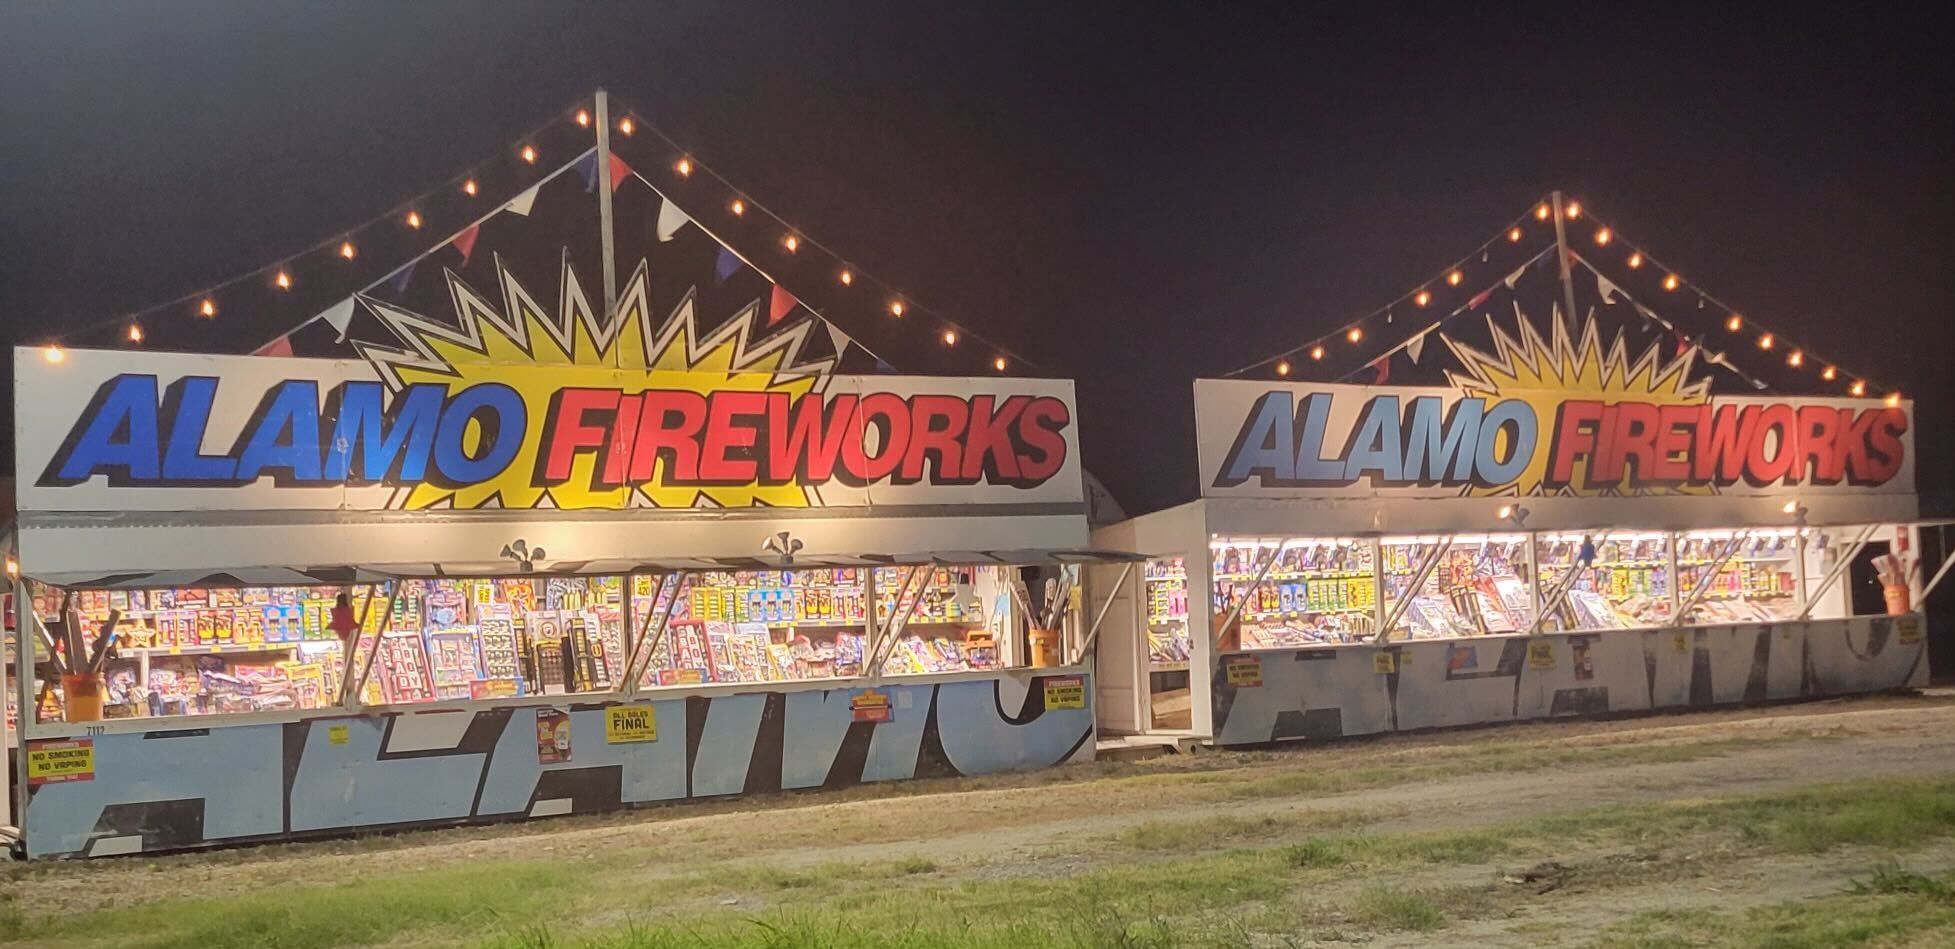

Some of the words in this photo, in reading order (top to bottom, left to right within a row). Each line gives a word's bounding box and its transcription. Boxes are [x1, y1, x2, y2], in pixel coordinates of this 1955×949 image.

[34, 373, 528, 489] ALAMO
[530, 386, 1069, 489] FIREWORKS
[1212, 391, 1538, 487] ALAMO
[1544, 399, 1908, 488] FIREWORKS
[613, 718, 650, 730] FINAL
[32, 753, 45, 761] NO
[48, 749, 90, 760] SMOKING
[38, 763, 51, 771] NO
[54, 760, 88, 769] VAPING
